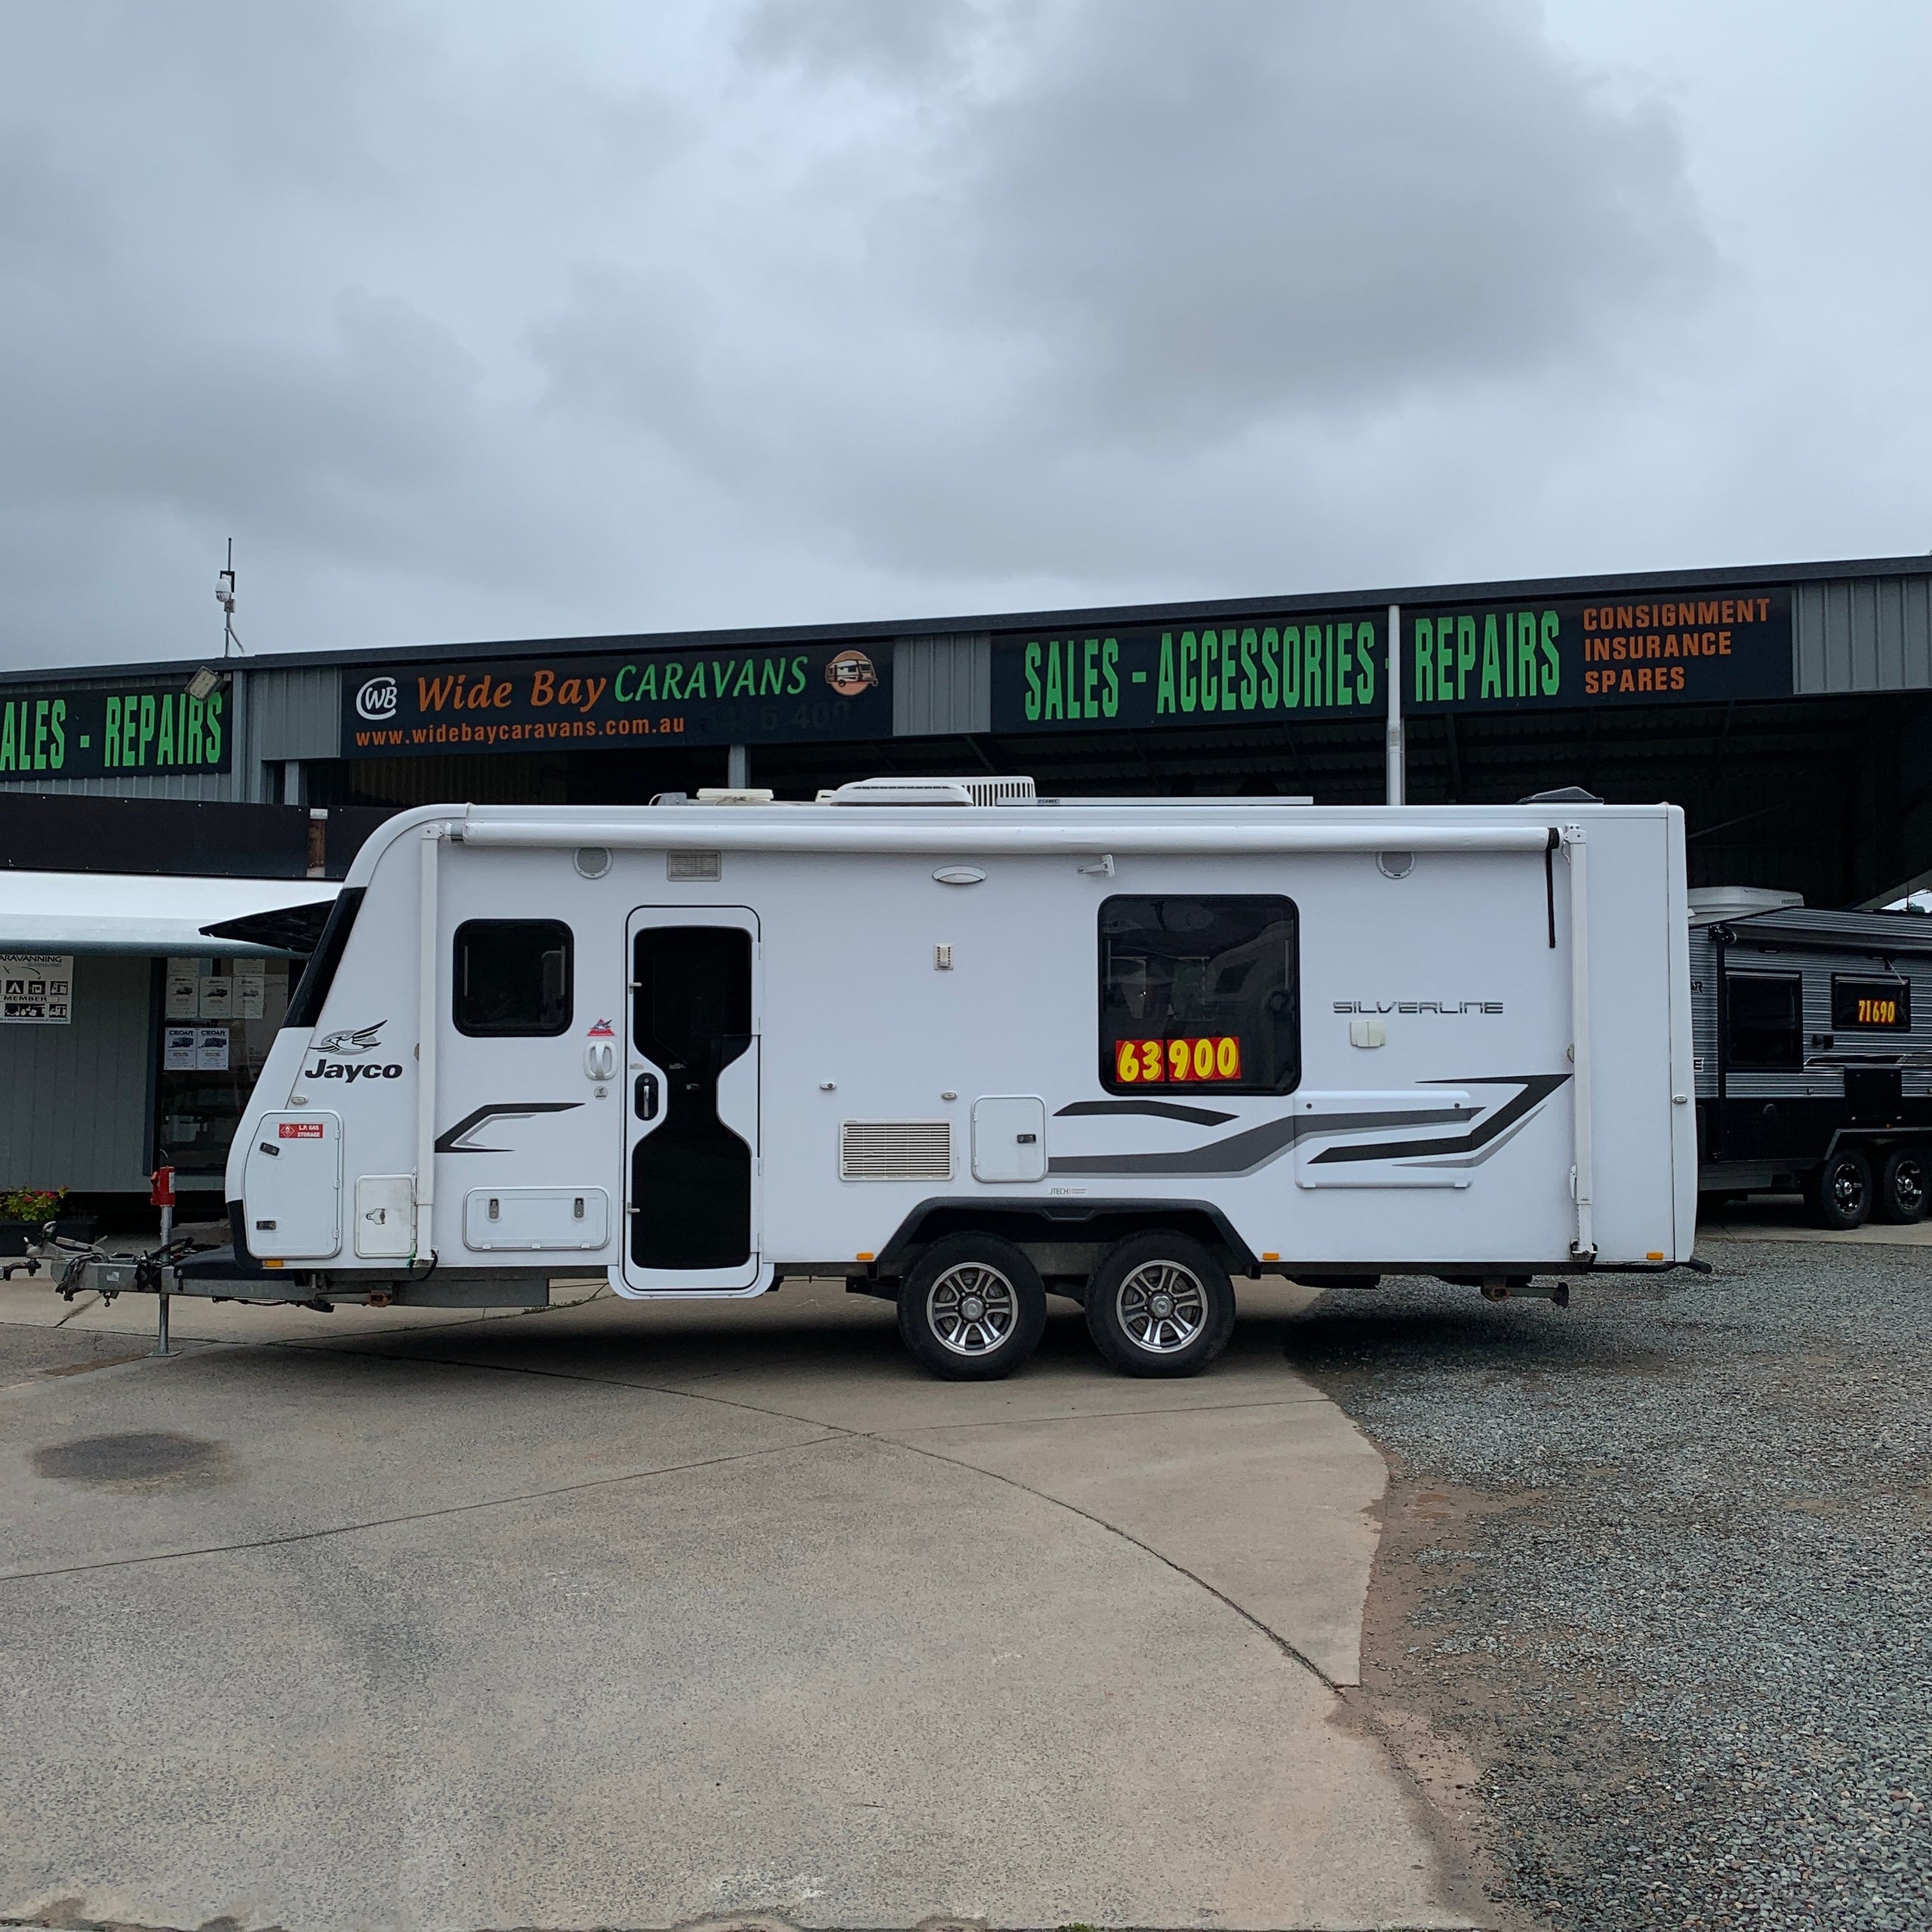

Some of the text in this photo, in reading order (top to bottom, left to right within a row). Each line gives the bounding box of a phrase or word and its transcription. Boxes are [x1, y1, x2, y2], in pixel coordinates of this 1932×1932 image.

[1583, 598, 1770, 631] CONSIGNMENT
[1585, 632, 1731, 662] INSURANCE
[1025, 638, 1118, 721] SALES
[1157, 622, 1374, 714] ACCESSORIES
[1415, 611, 1560, 702] REPAIRS
[1586, 666, 1685, 694] SPARES
[418, 656, 808, 712] Wide Bay CARAVANS
[104, 692, 223, 768] REPAIRS
[355, 716, 685, 746] www.widebaycaravans.com.au
[1333, 1001, 1503, 1014] SILVERLINE
[1859, 1000, 1895, 1023] 71690
[305, 1059, 403, 1083] Jayco
[1118, 1037, 1238, 1081] 63900
